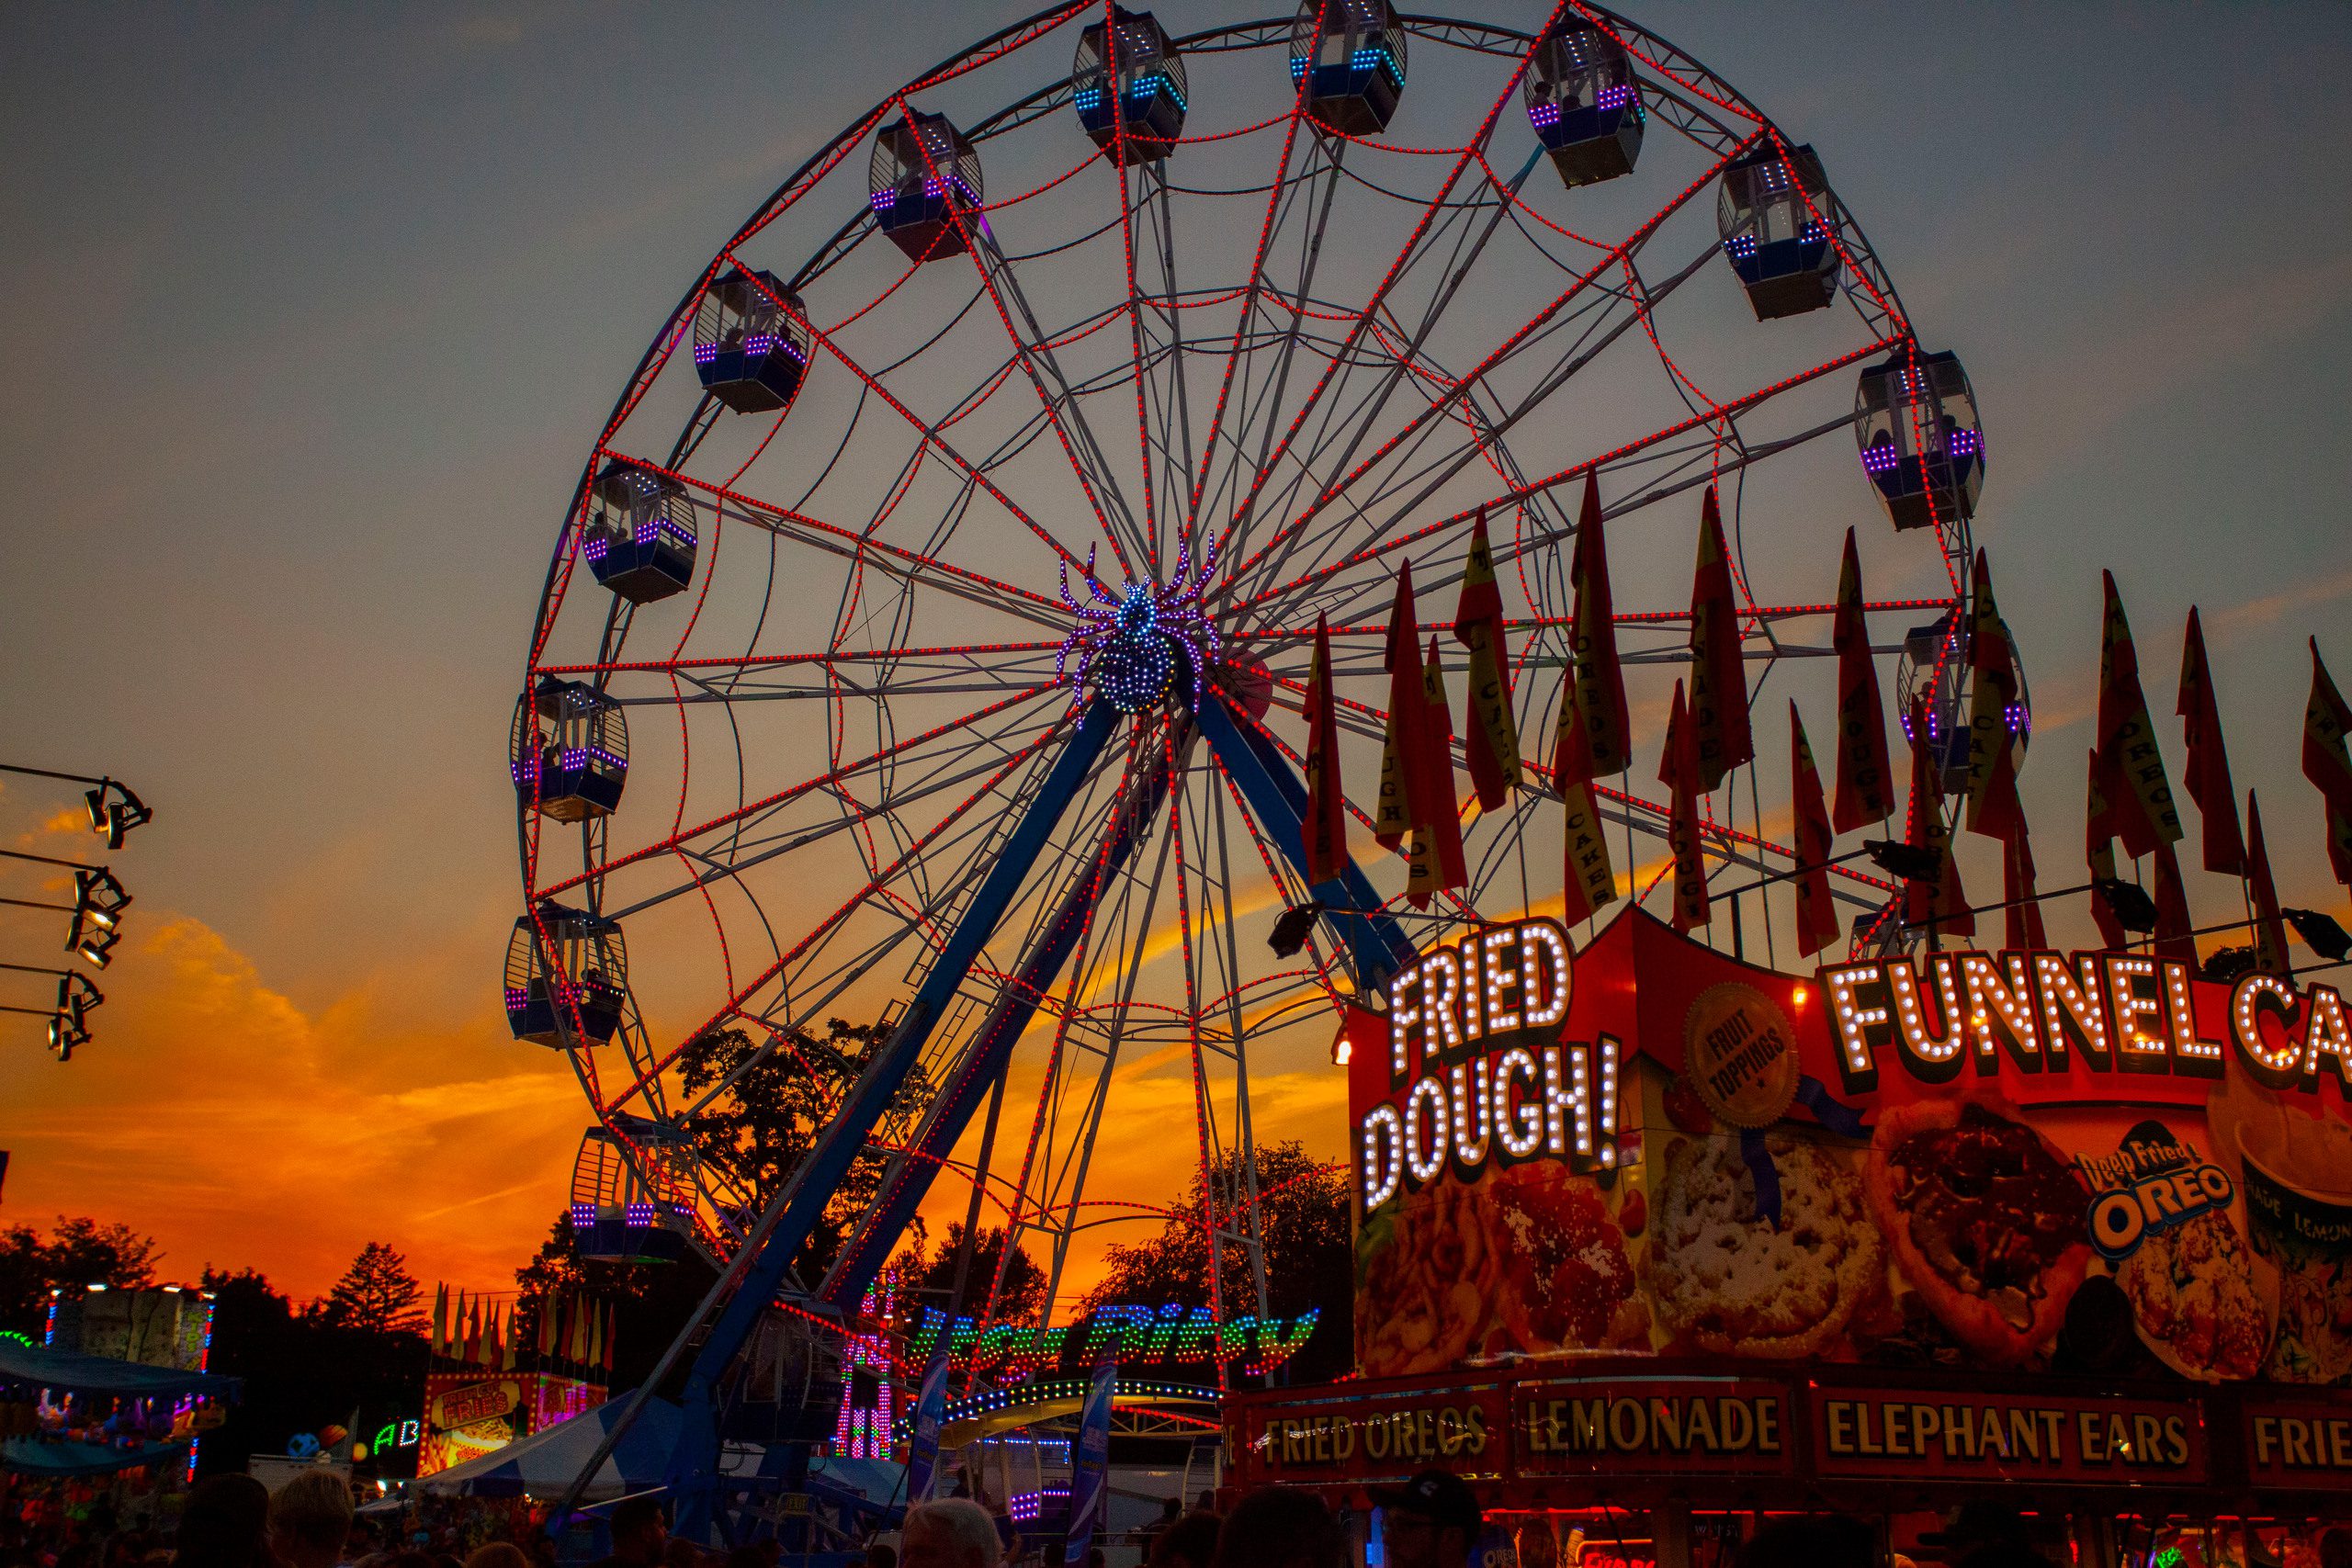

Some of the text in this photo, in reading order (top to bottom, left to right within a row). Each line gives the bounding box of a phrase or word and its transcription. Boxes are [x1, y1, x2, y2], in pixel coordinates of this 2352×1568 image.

[2118, 721, 2179, 829] OREOS
[1566, 813, 1610, 907] CAKES
[1391, 921, 1571, 1077] FRIED
[1706, 1009, 1754, 1061] FRUIT
[1826, 955, 2222, 1074] FUNNEL
[1709, 1027, 1784, 1101] TOPPINGS
[1363, 1037, 1619, 1214] DOUGH!
[2075, 1152, 2137, 1192] Deep
[2091, 1167, 2232, 1251] OREO
[443, 1391, 509, 1427] FRIES
[1264, 1404, 1486, 1464] FRIED OREOS
[1528, 1397, 1781, 1451] LEMONADE
[1826, 1401, 2188, 1465] ELEPHANT EARS
